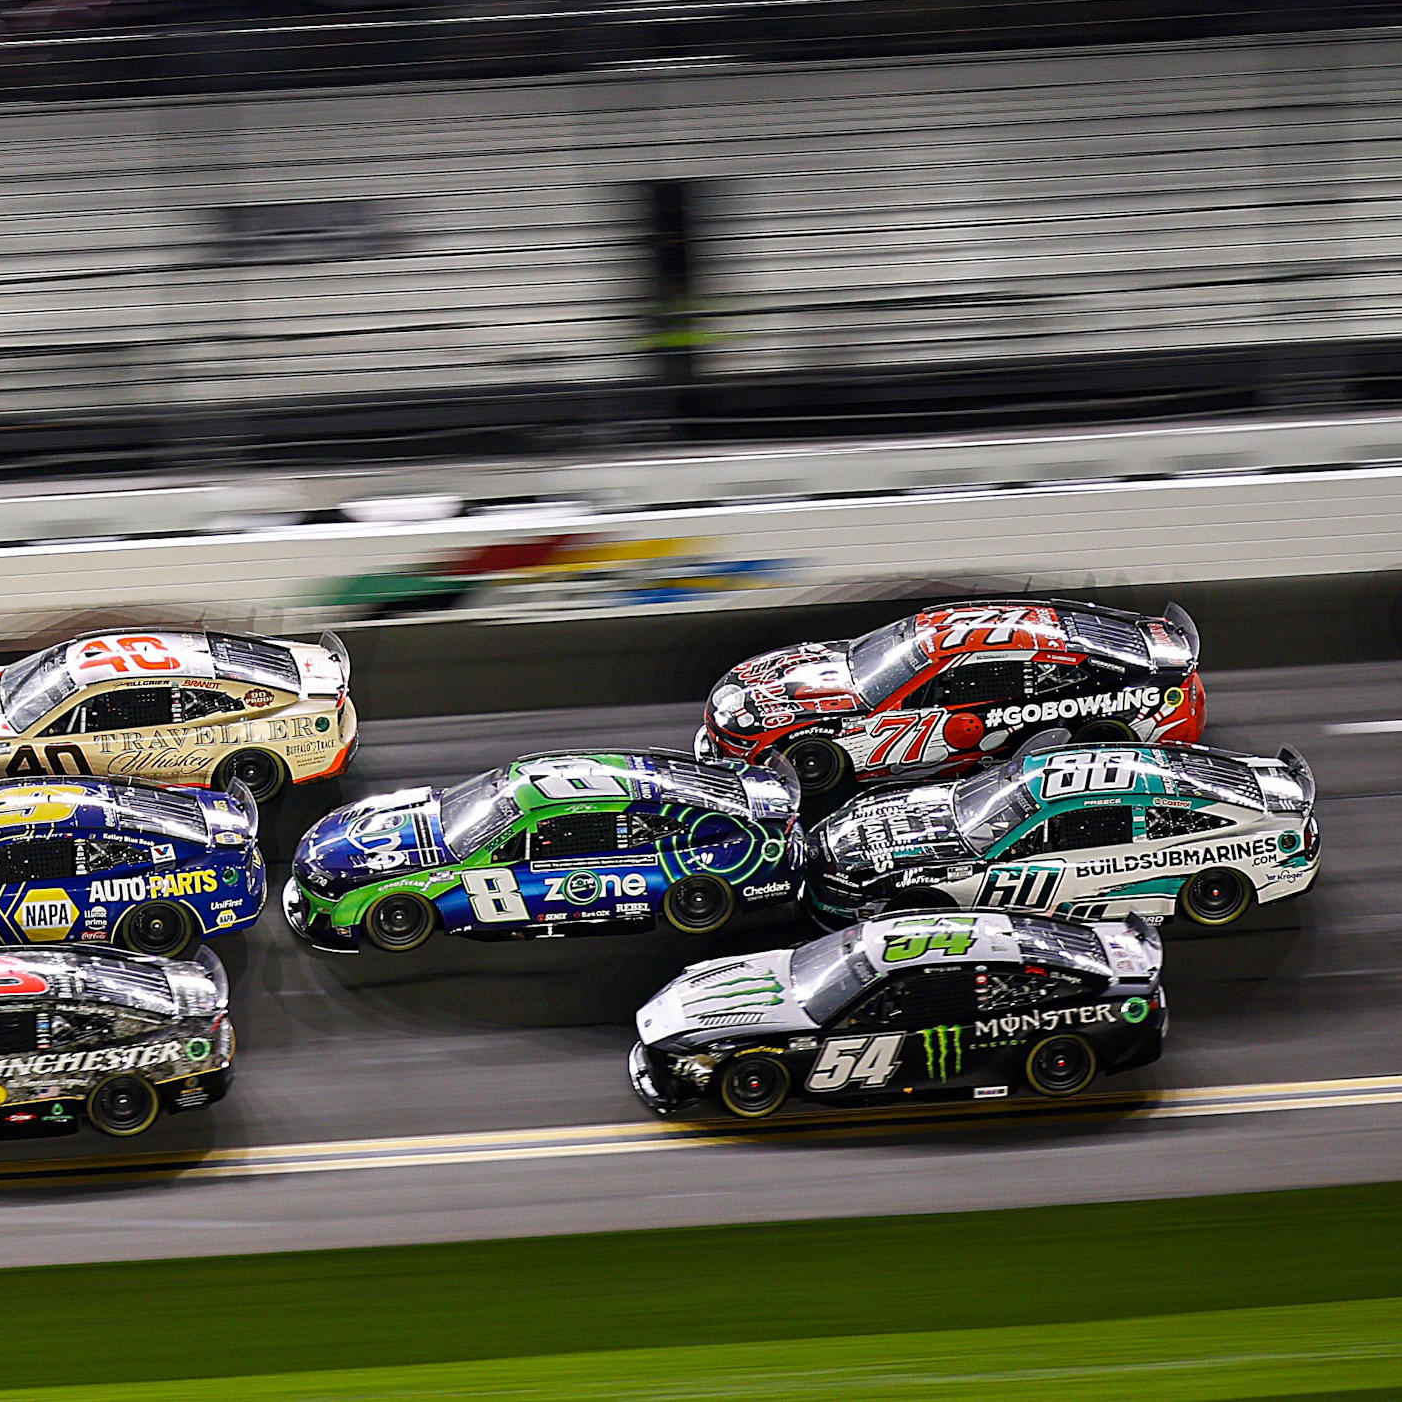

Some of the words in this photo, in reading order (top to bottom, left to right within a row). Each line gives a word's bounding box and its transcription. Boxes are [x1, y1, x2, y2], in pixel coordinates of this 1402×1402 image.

[76, 636, 181, 673] 40
[181, 679, 222, 691] BRANDT
[984, 686, 1161, 729] #GOBOWLING
[93, 715, 316, 755] TRAVELLER
[788, 726, 835, 741] GOODYEAR
[866, 708, 946, 769] 71
[5, 743, 94, 777] 40
[107, 747, 215, 776] Whiskey
[286, 743, 314, 757] BUFFALO
[1160, 798, 1192, 810] Castrol
[1075, 837, 1278, 879] BUILDSUBMARINES
[1251, 853, 1278, 867] .COM
[88, 879, 146, 903] AUTO
[148, 869, 218, 899] PARTS
[460, 868, 531, 923] 8
[543, 868, 648, 906] zone
[742, 880, 791, 897] Cheddar's
[975, 861, 1066, 910] 60
[25, 903, 70, 927] NAPA
[210, 898, 244, 910] UniFirst
[218, 913, 235, 924] NAPA
[615, 902, 651, 913] REBEL
[85, 918, 108, 928] prime
[883, 916, 978, 962] 54
[805, 1031, 907, 1093] 54
